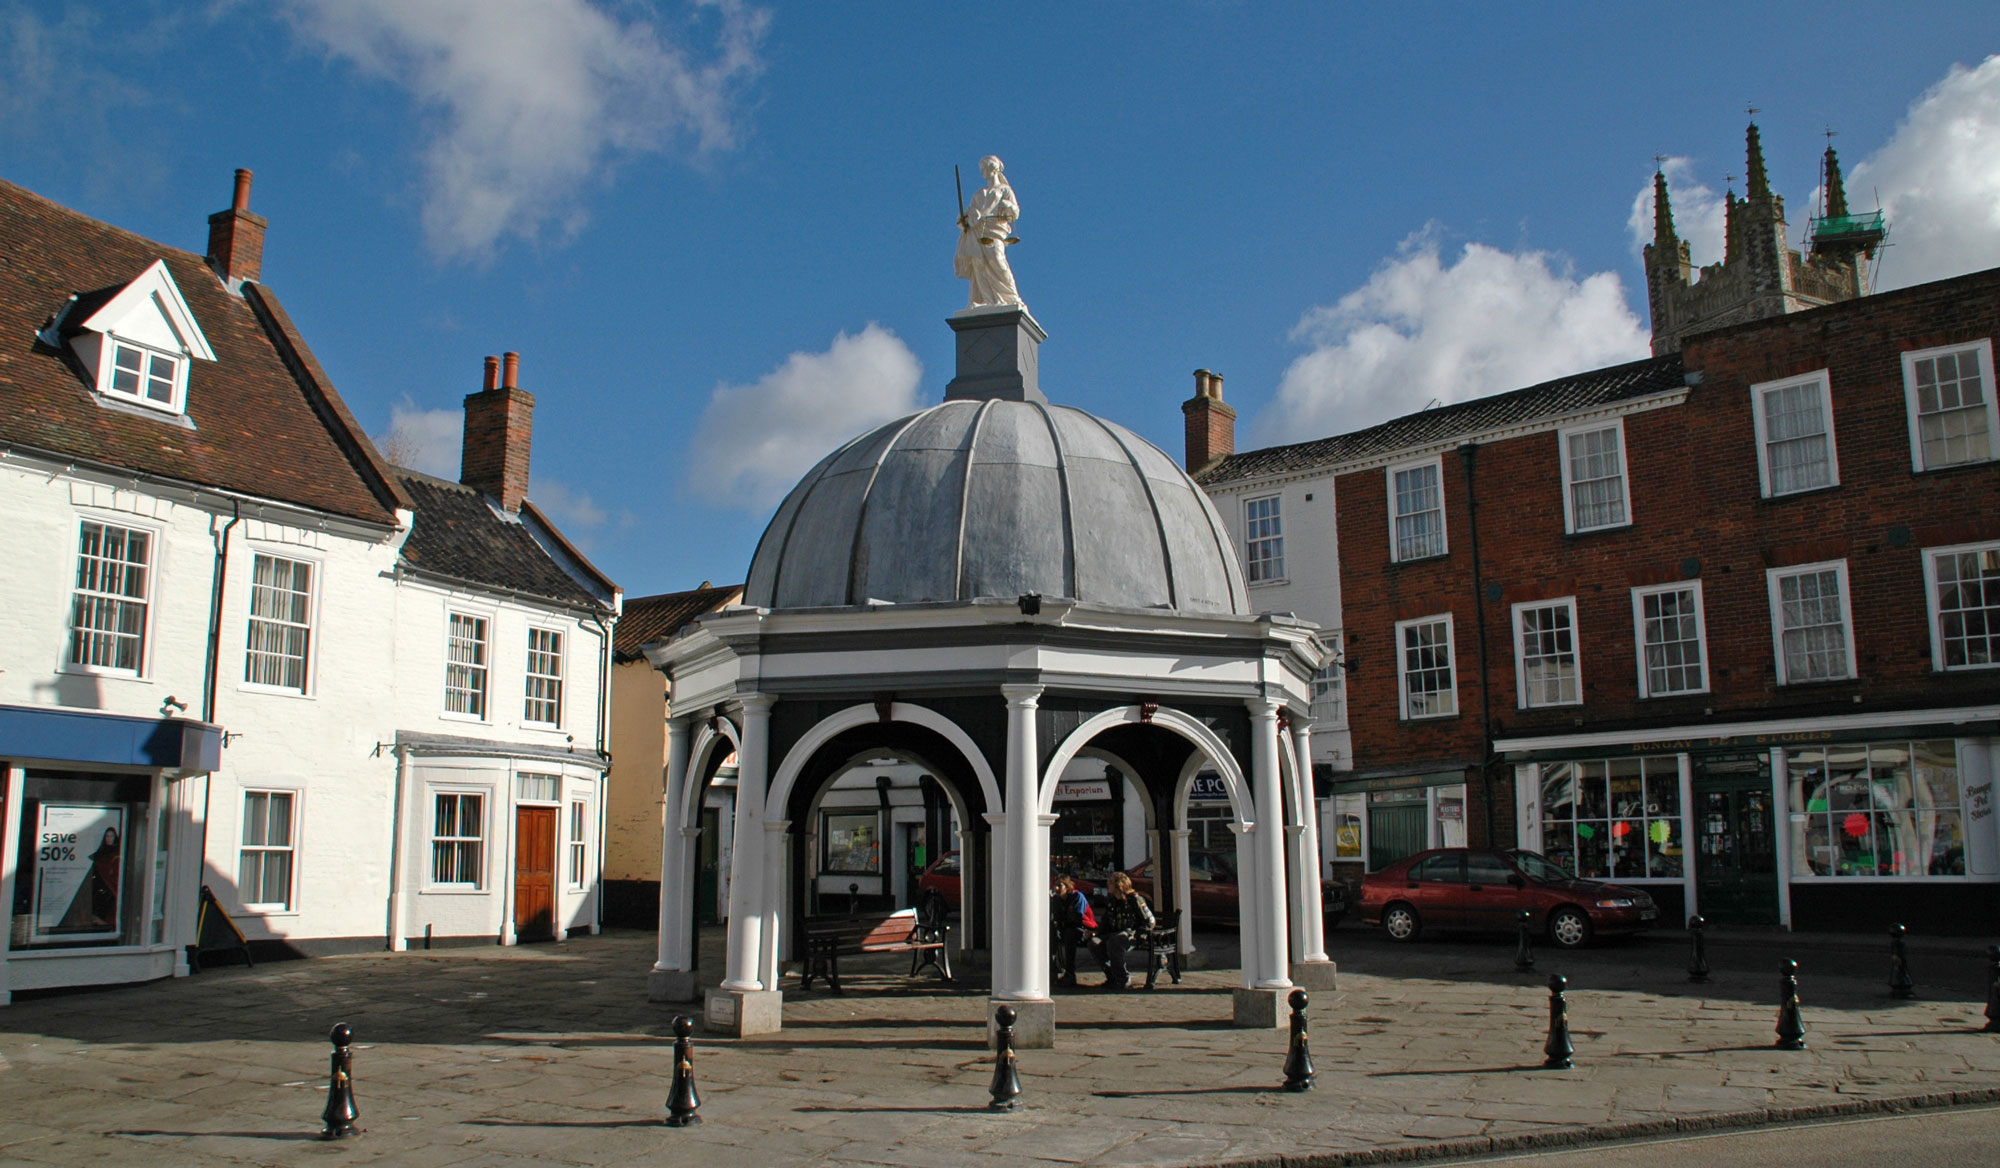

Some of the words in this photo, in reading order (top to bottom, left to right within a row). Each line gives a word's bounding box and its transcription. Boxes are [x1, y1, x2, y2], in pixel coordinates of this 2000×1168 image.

[1632, 738, 1693, 751] BUNGAY
[1708, 736, 1740, 747] PET
[1756, 731, 1833, 744] STORES
[1064, 784, 1104, 797] Emporium
[42, 832, 77, 843] save
[40, 846, 76, 861] 50%
